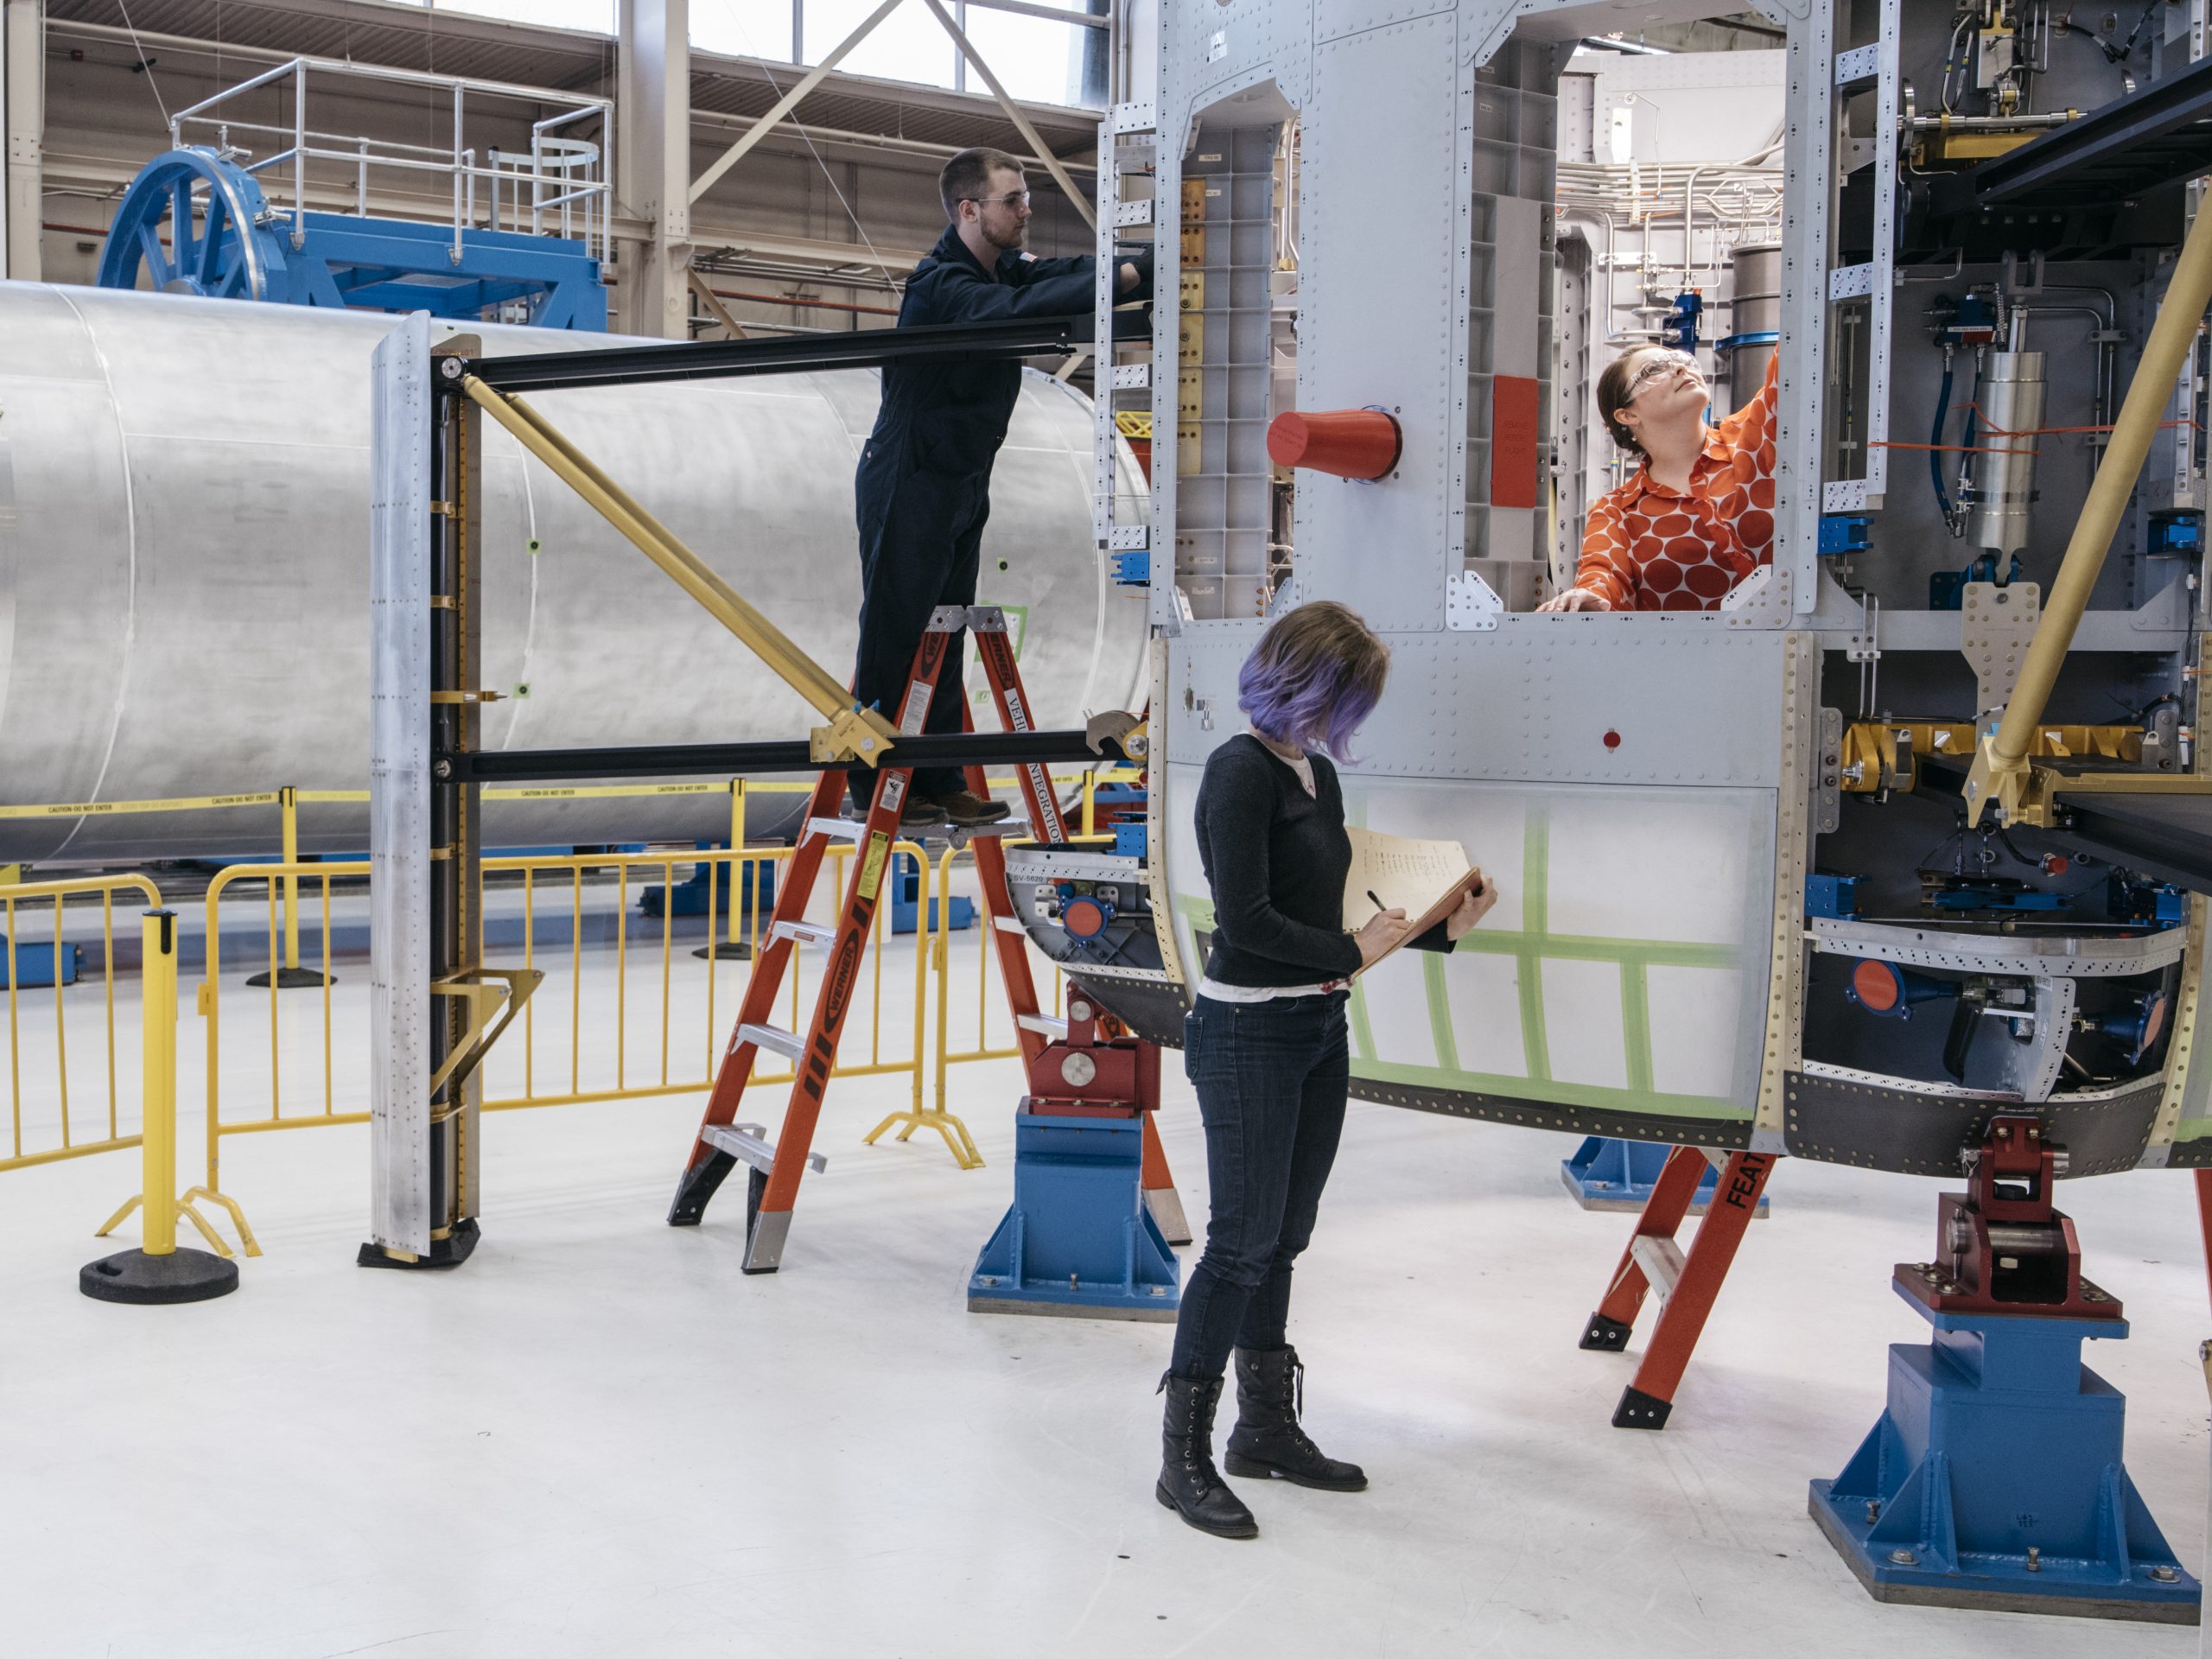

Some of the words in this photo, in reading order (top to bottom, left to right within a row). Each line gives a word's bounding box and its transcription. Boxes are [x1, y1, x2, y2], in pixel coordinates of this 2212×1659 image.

[991, 632, 1011, 683] ERNER
[1009, 697, 1027, 731] VEHI
[1030, 764, 1062, 843] NTEGRATION
[830, 946, 854, 1010] WERNER
